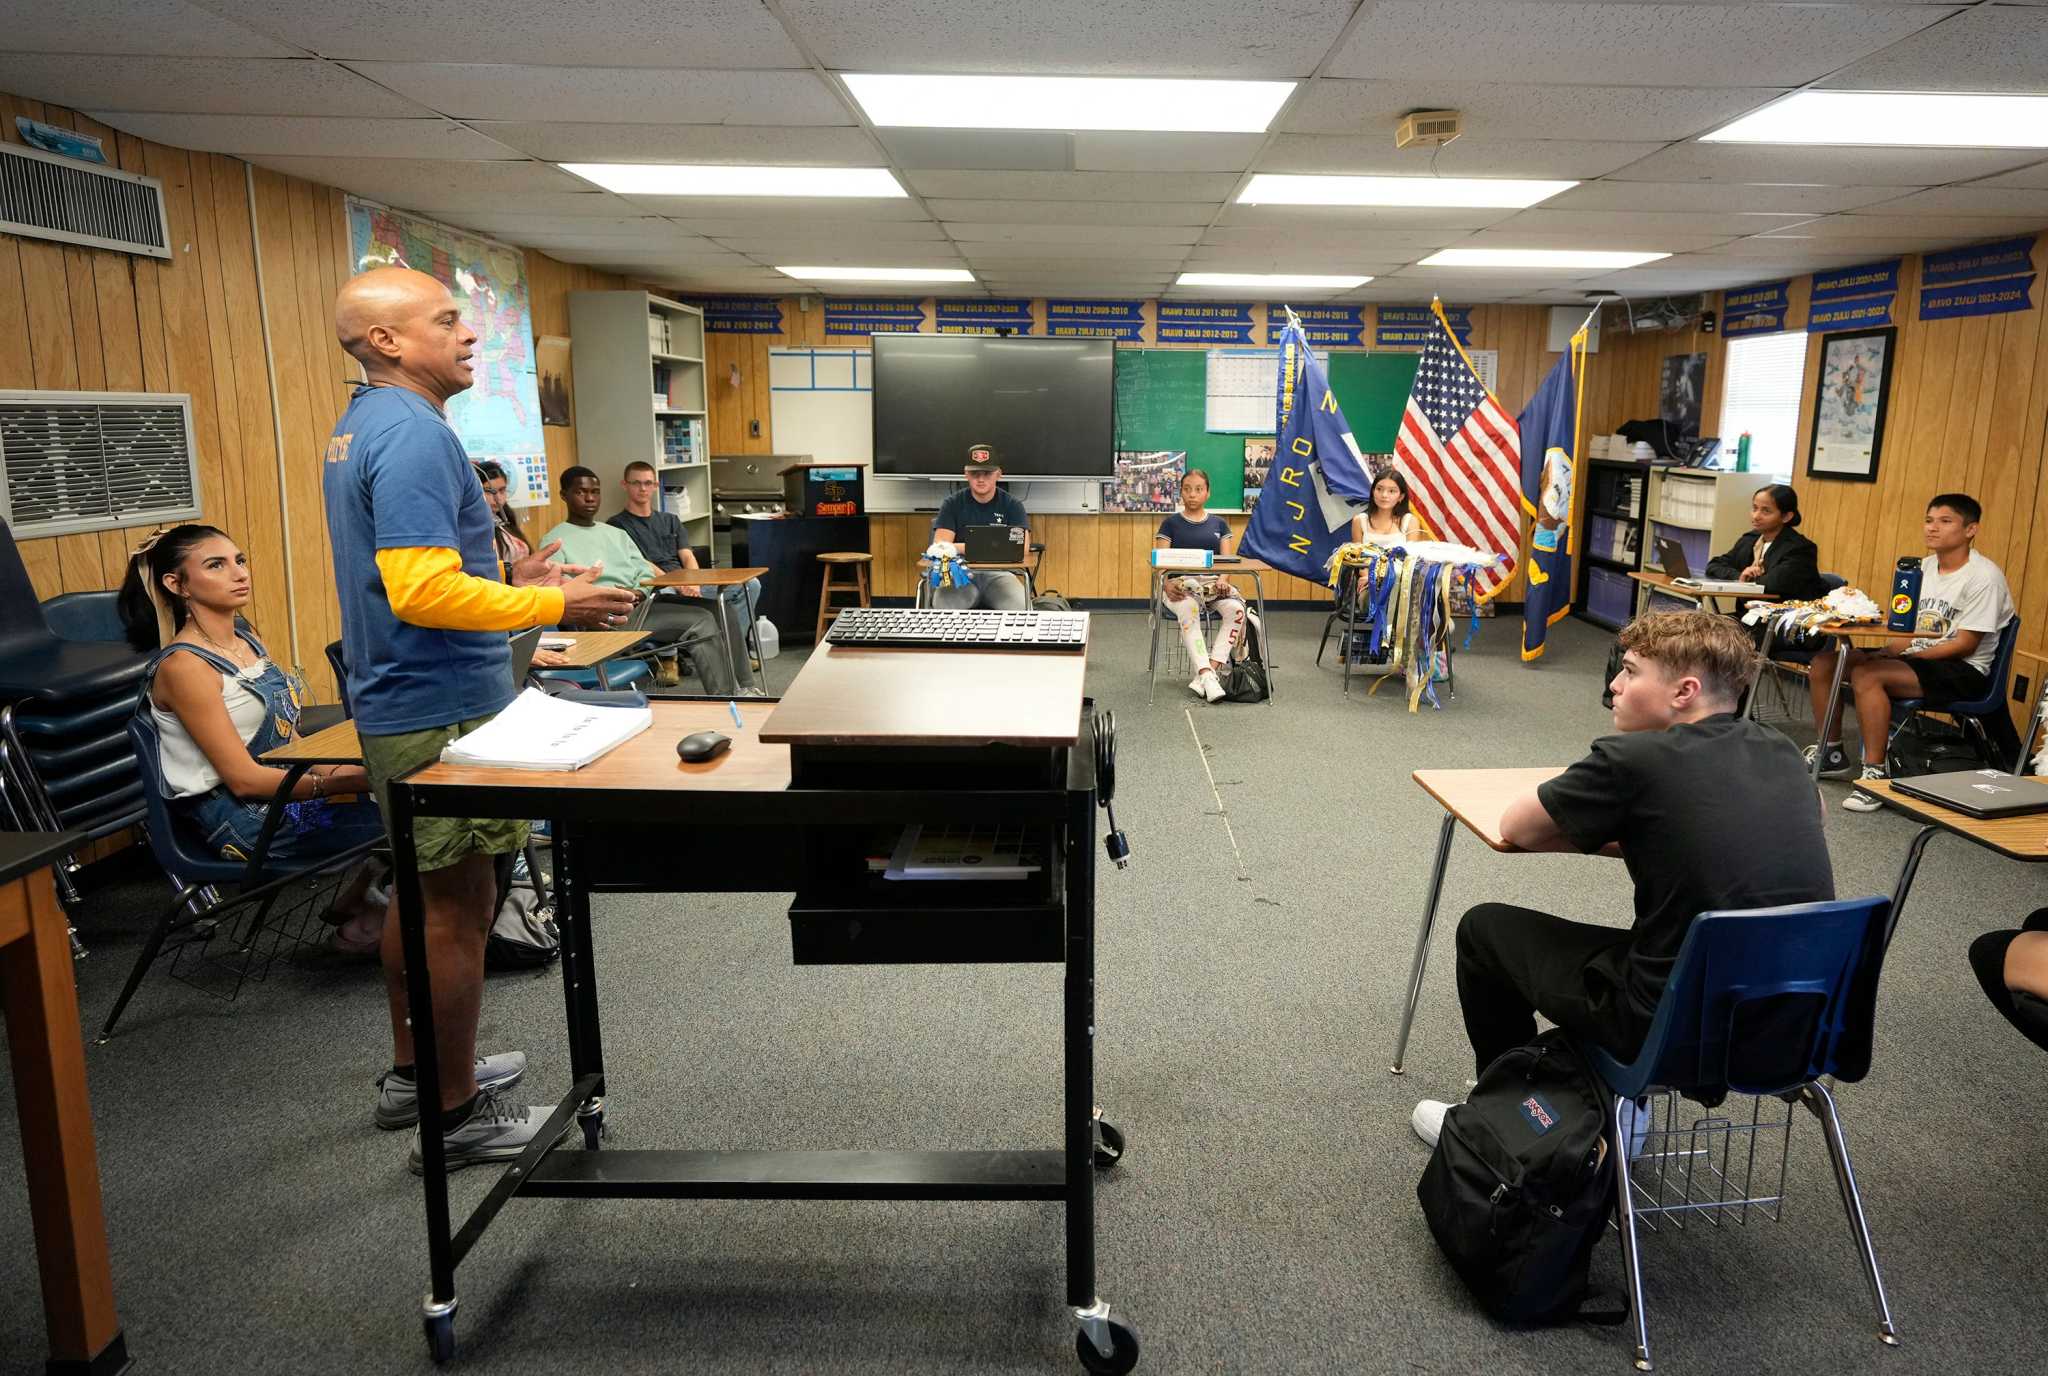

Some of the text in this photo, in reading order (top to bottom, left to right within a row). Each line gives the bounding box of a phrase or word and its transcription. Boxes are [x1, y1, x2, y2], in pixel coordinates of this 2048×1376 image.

[1053, 305, 1128, 315] BRAVO ZULU 2009-2010
[1161, 307, 1238, 317] BRAVO ZULU 2011-2012
[942, 326, 963, 334] BRAVO
[964, 326, 981, 334] ZULU
[1055, 327, 1131, 336] BRAVO ZULU 2010-2011
[1162, 328, 1238, 339] BRAVO ZULU 2012-2013
[1382, 332, 1404, 341] BRAVO
